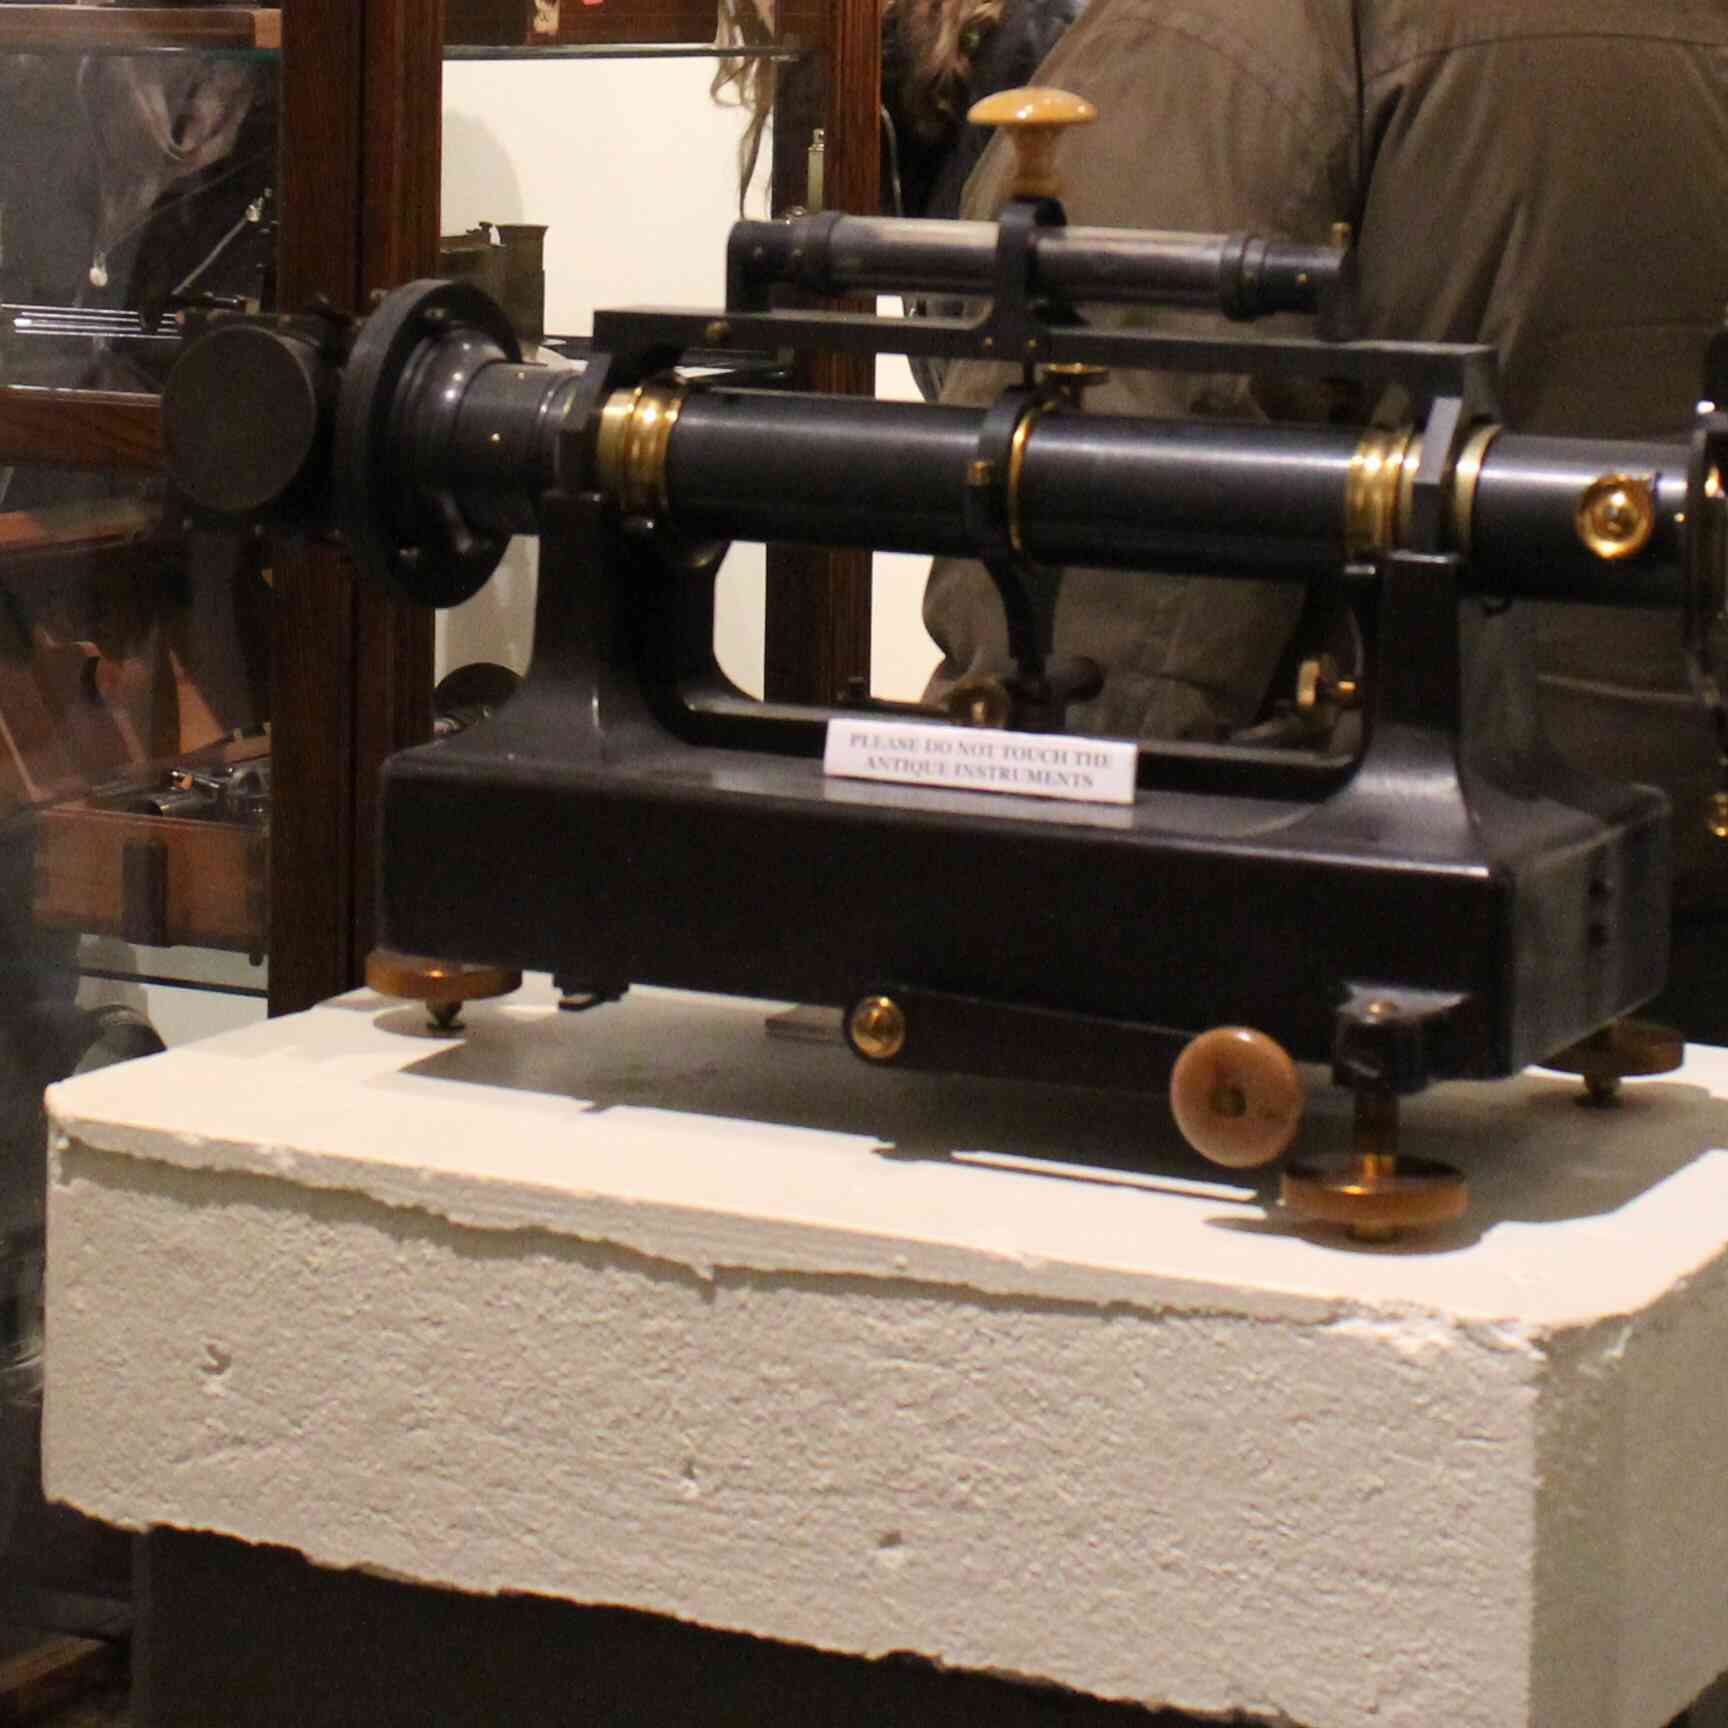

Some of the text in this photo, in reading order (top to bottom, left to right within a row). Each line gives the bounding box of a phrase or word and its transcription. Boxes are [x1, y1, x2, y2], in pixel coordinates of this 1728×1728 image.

[849, 732, 1111, 768] PLEASE DO NOT TOUCH THE
[866, 756, 1094, 788] ANTIQUE INSTRUMENTS
